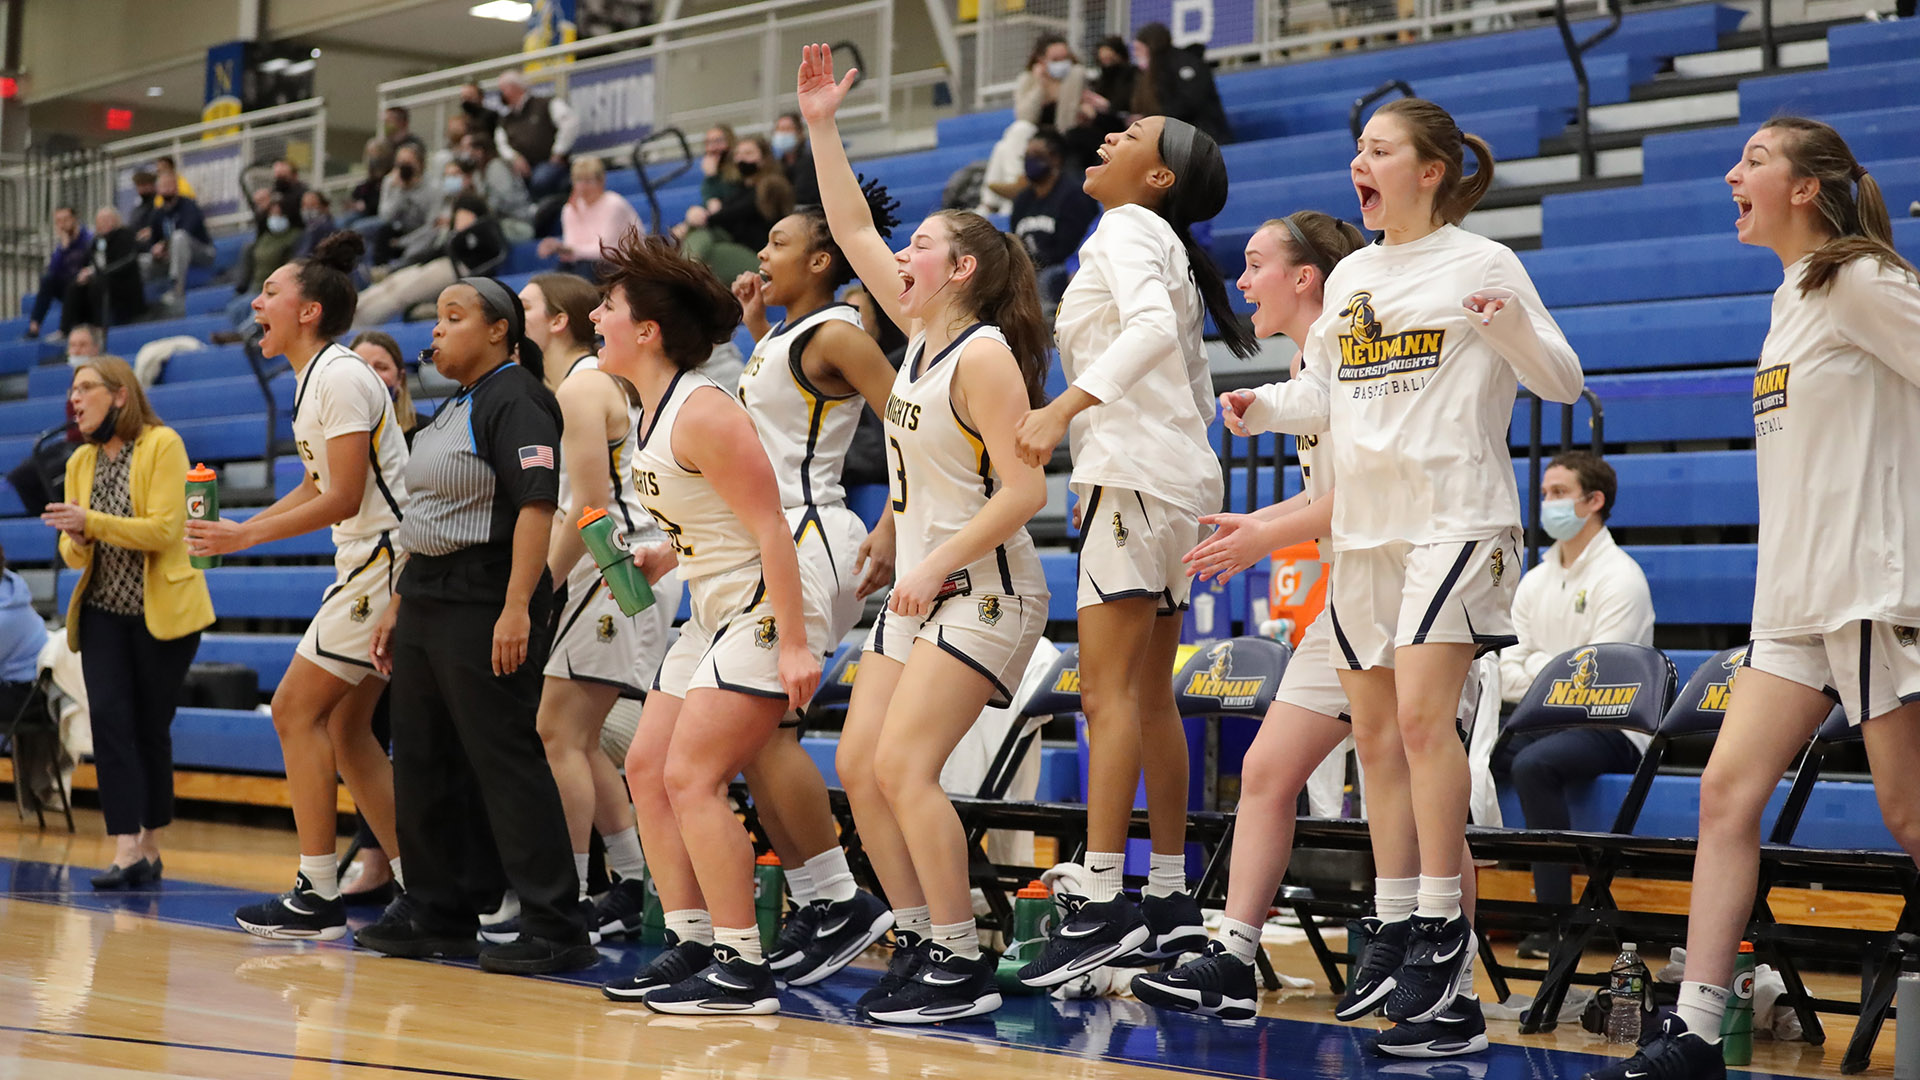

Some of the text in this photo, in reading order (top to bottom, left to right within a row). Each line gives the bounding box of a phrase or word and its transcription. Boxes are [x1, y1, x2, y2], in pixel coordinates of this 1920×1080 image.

[1340, 333, 1440, 366] NEUMANN
[1753, 367, 1787, 399] MANN
[885, 392, 922, 431] NIGHTS
[1276, 565, 1296, 596] G
[1187, 673, 1263, 697] NEUMANN
[1547, 682, 1637, 706] NEUMANN
[1590, 704, 1629, 716] KNIGHTS
